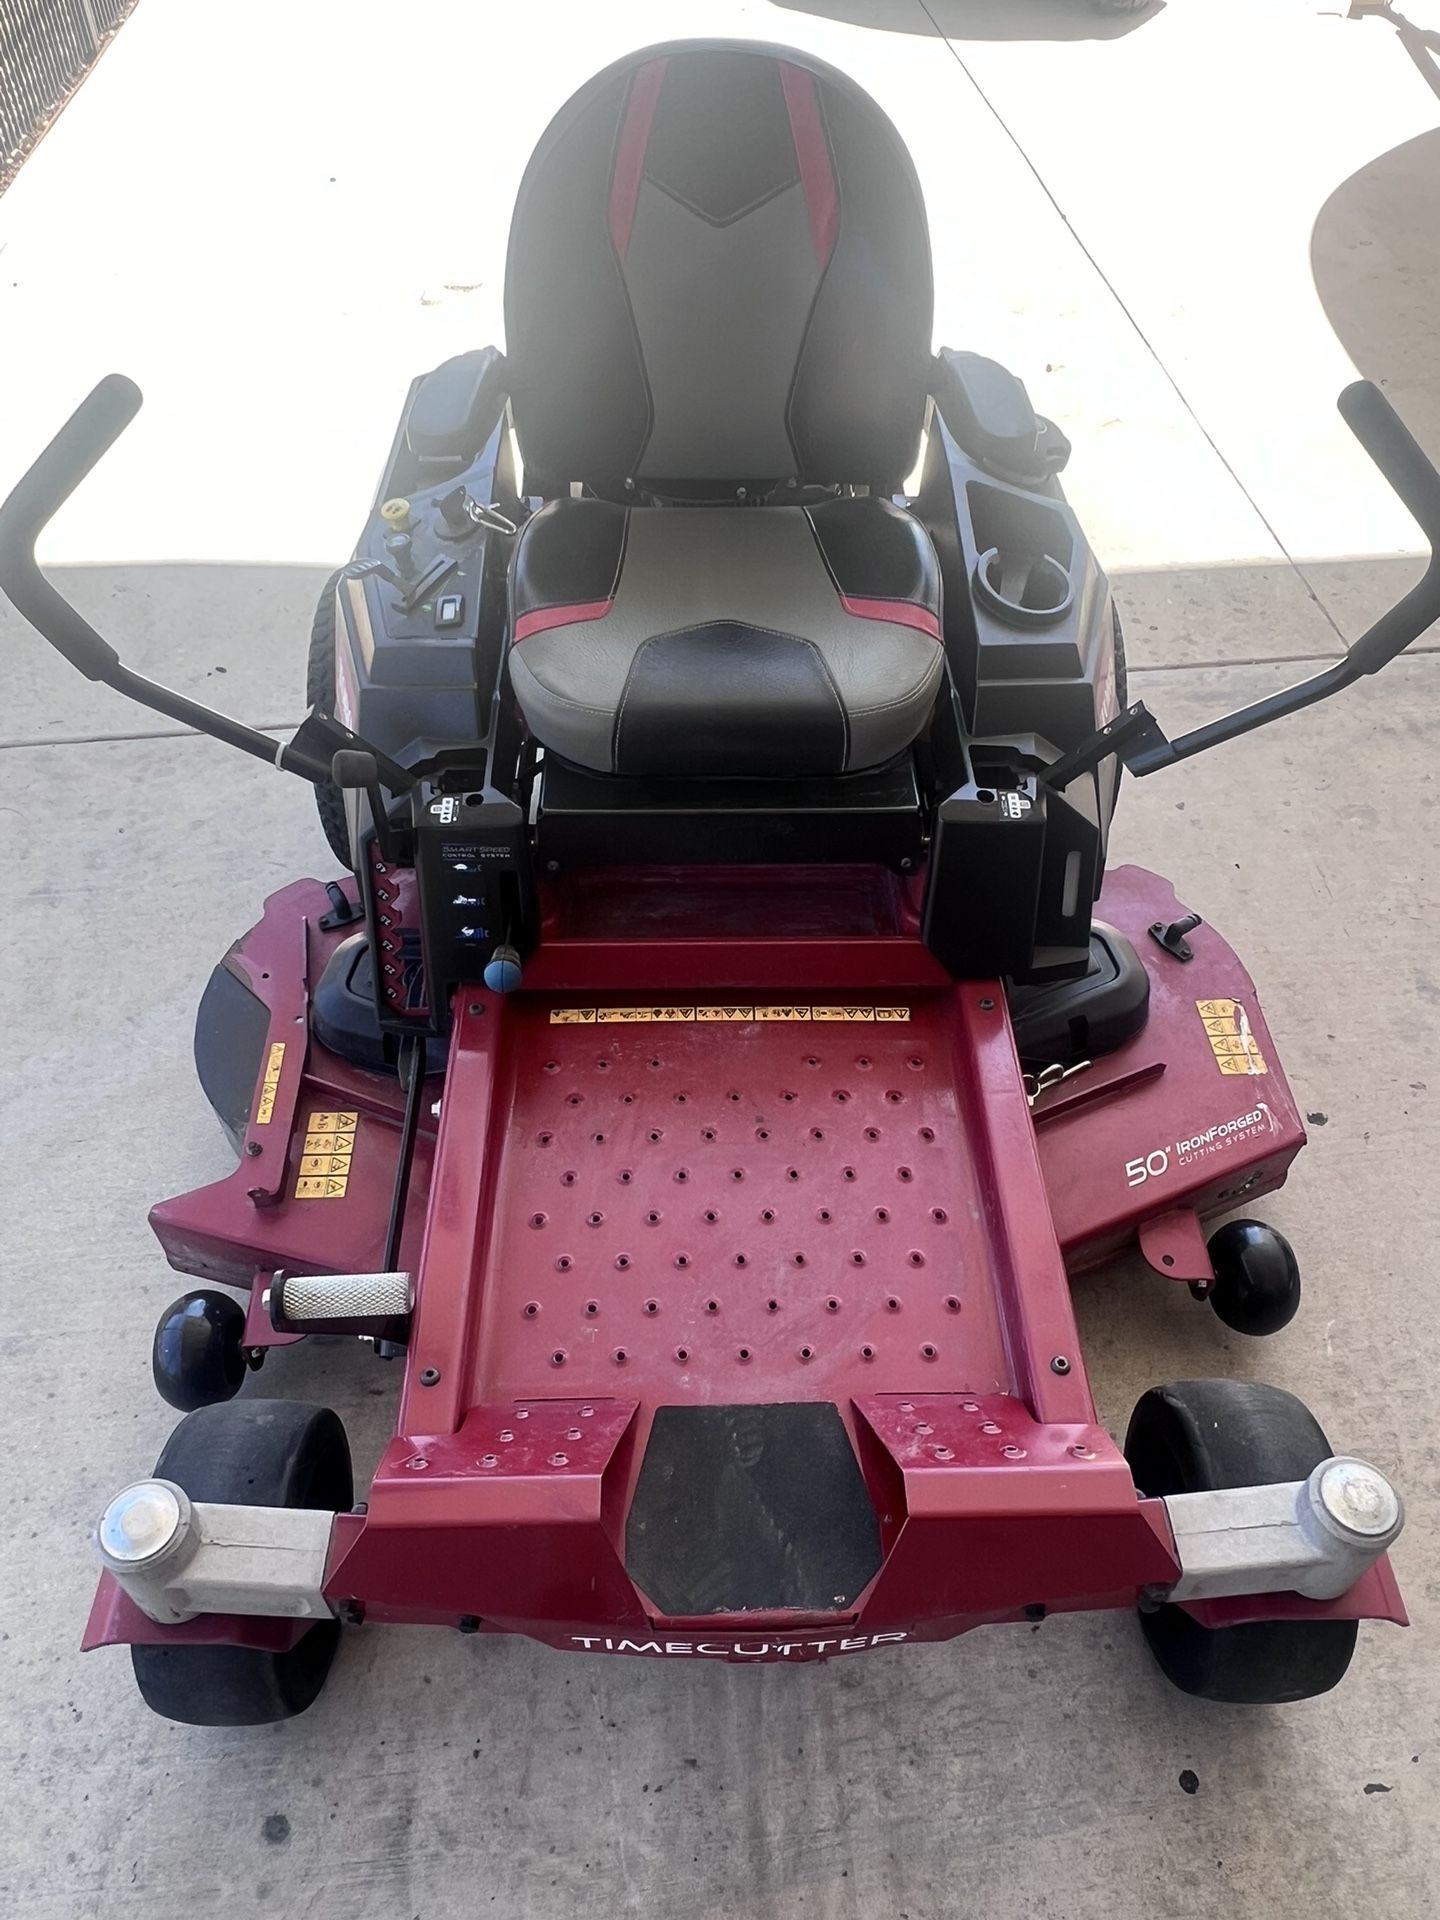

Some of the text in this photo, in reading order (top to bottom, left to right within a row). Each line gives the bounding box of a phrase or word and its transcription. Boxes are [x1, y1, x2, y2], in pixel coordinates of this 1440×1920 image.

[1176, 1110, 1262, 1155] IRONFORGED
[1178, 1124, 1265, 1166] CUTTING SYSTEM
[570, 1632, 909, 1656] TIMECUTTER
